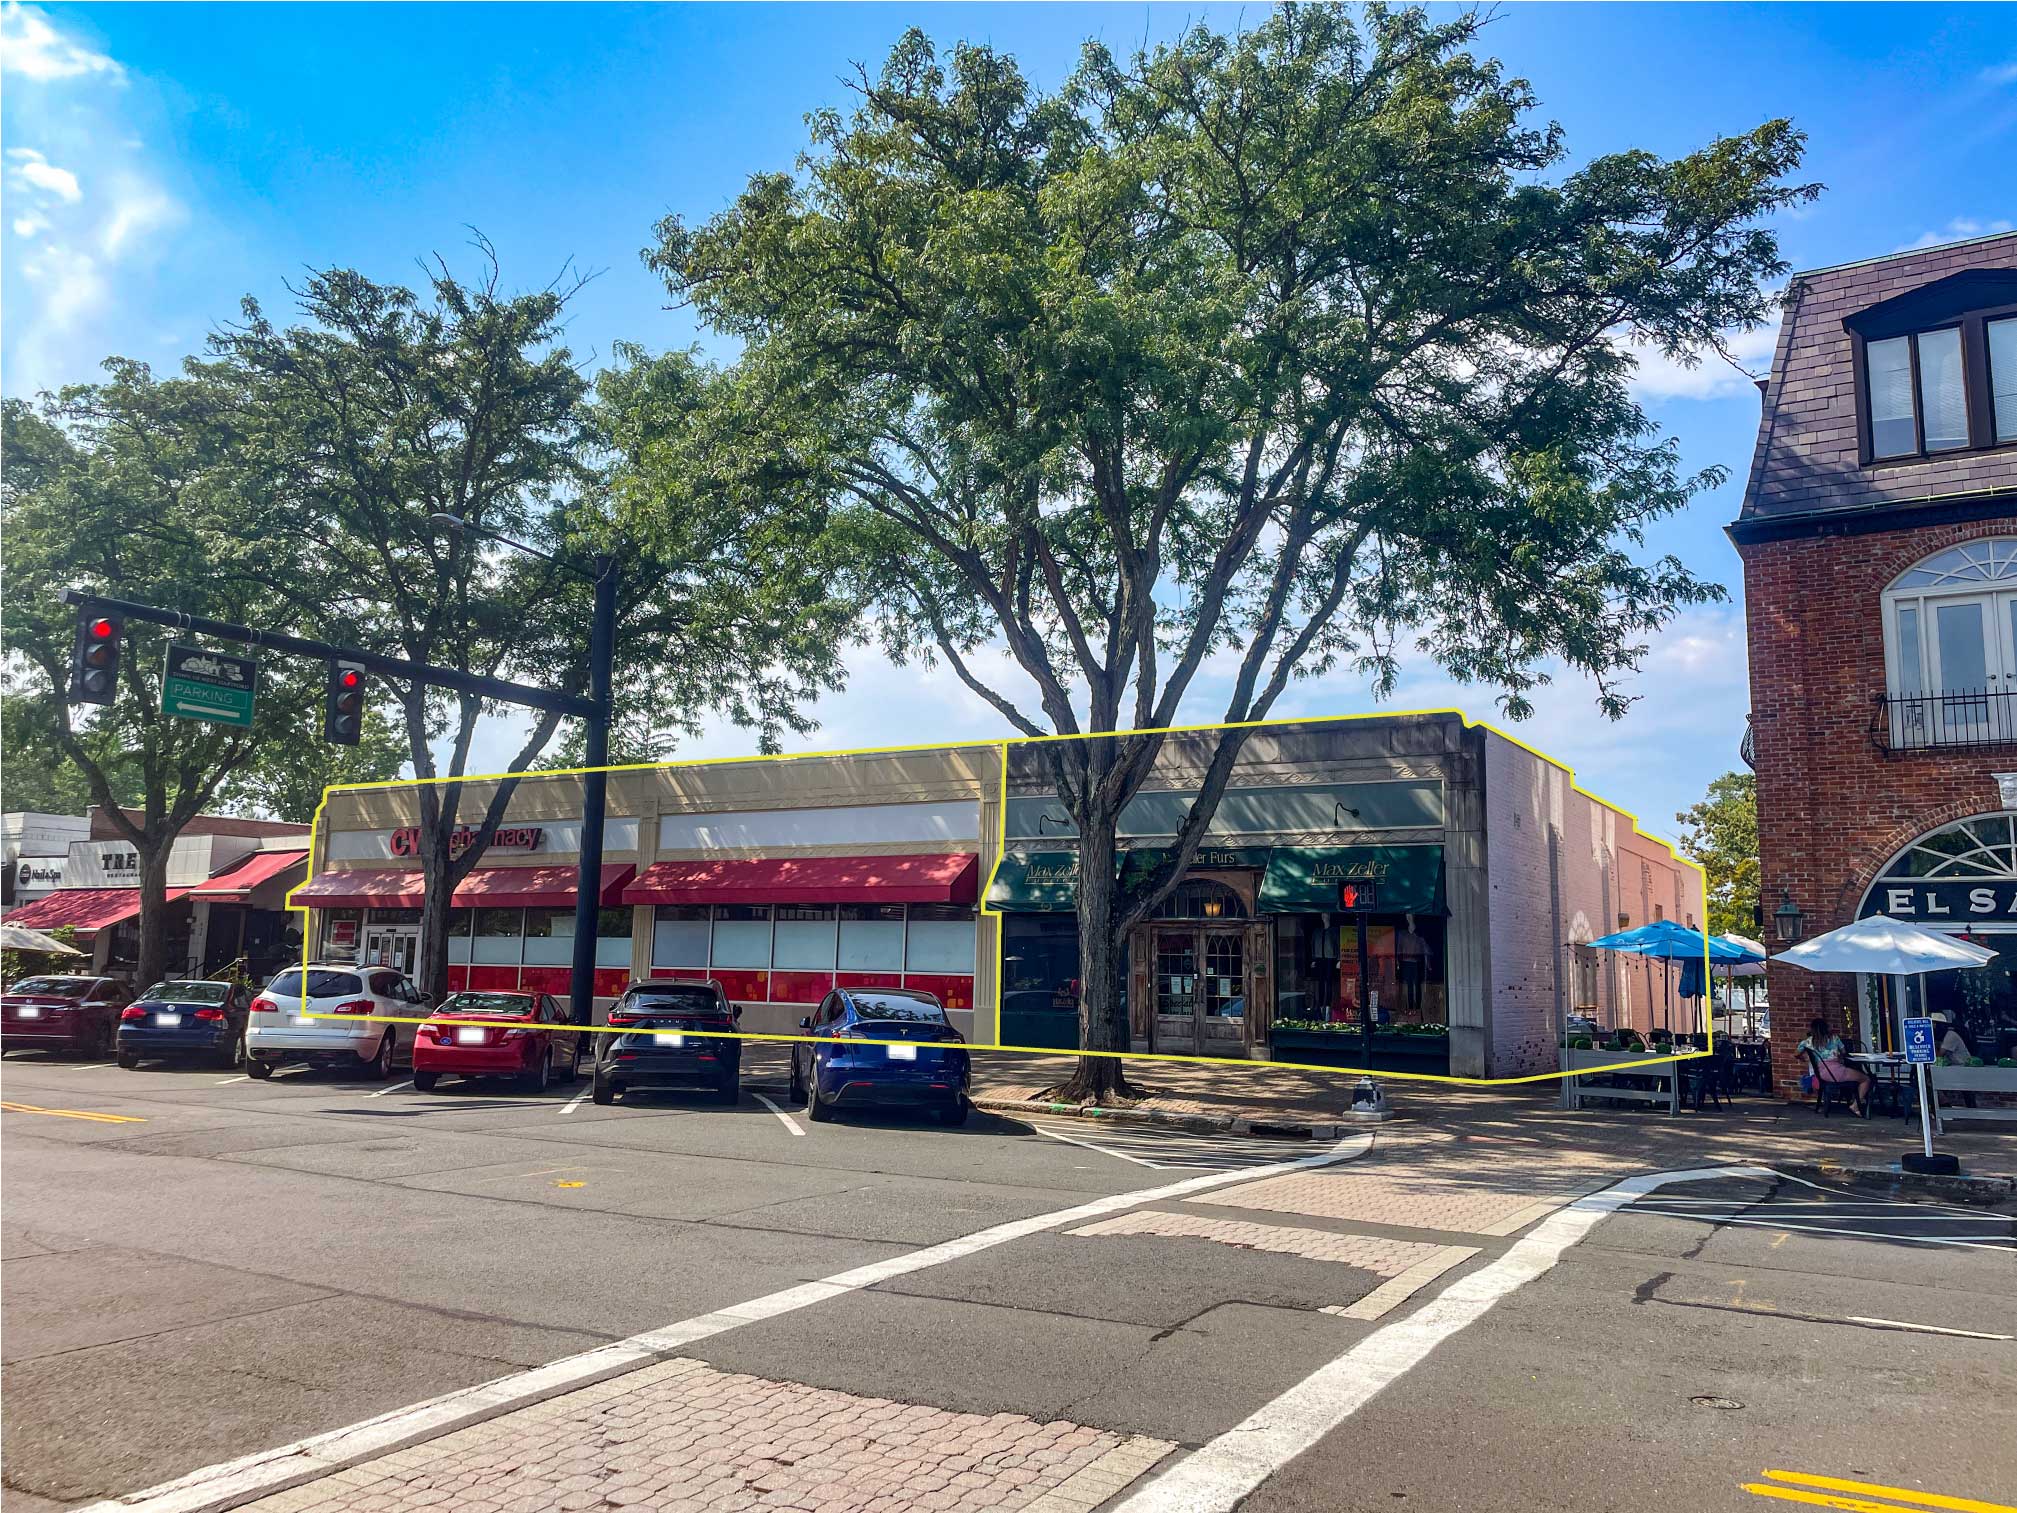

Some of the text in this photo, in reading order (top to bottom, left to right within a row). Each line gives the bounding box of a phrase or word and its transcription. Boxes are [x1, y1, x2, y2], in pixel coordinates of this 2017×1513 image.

[174, 684, 233, 704] PARKING
[390, 827, 422, 856] CV
[102, 852, 138, 870] TRE
[1210, 851, 1235, 864] Furs
[1026, 862, 1080, 877] Max Zell
[1312, 860, 1389, 876] Max Zeller
[1887, 888, 1950, 914] EL
